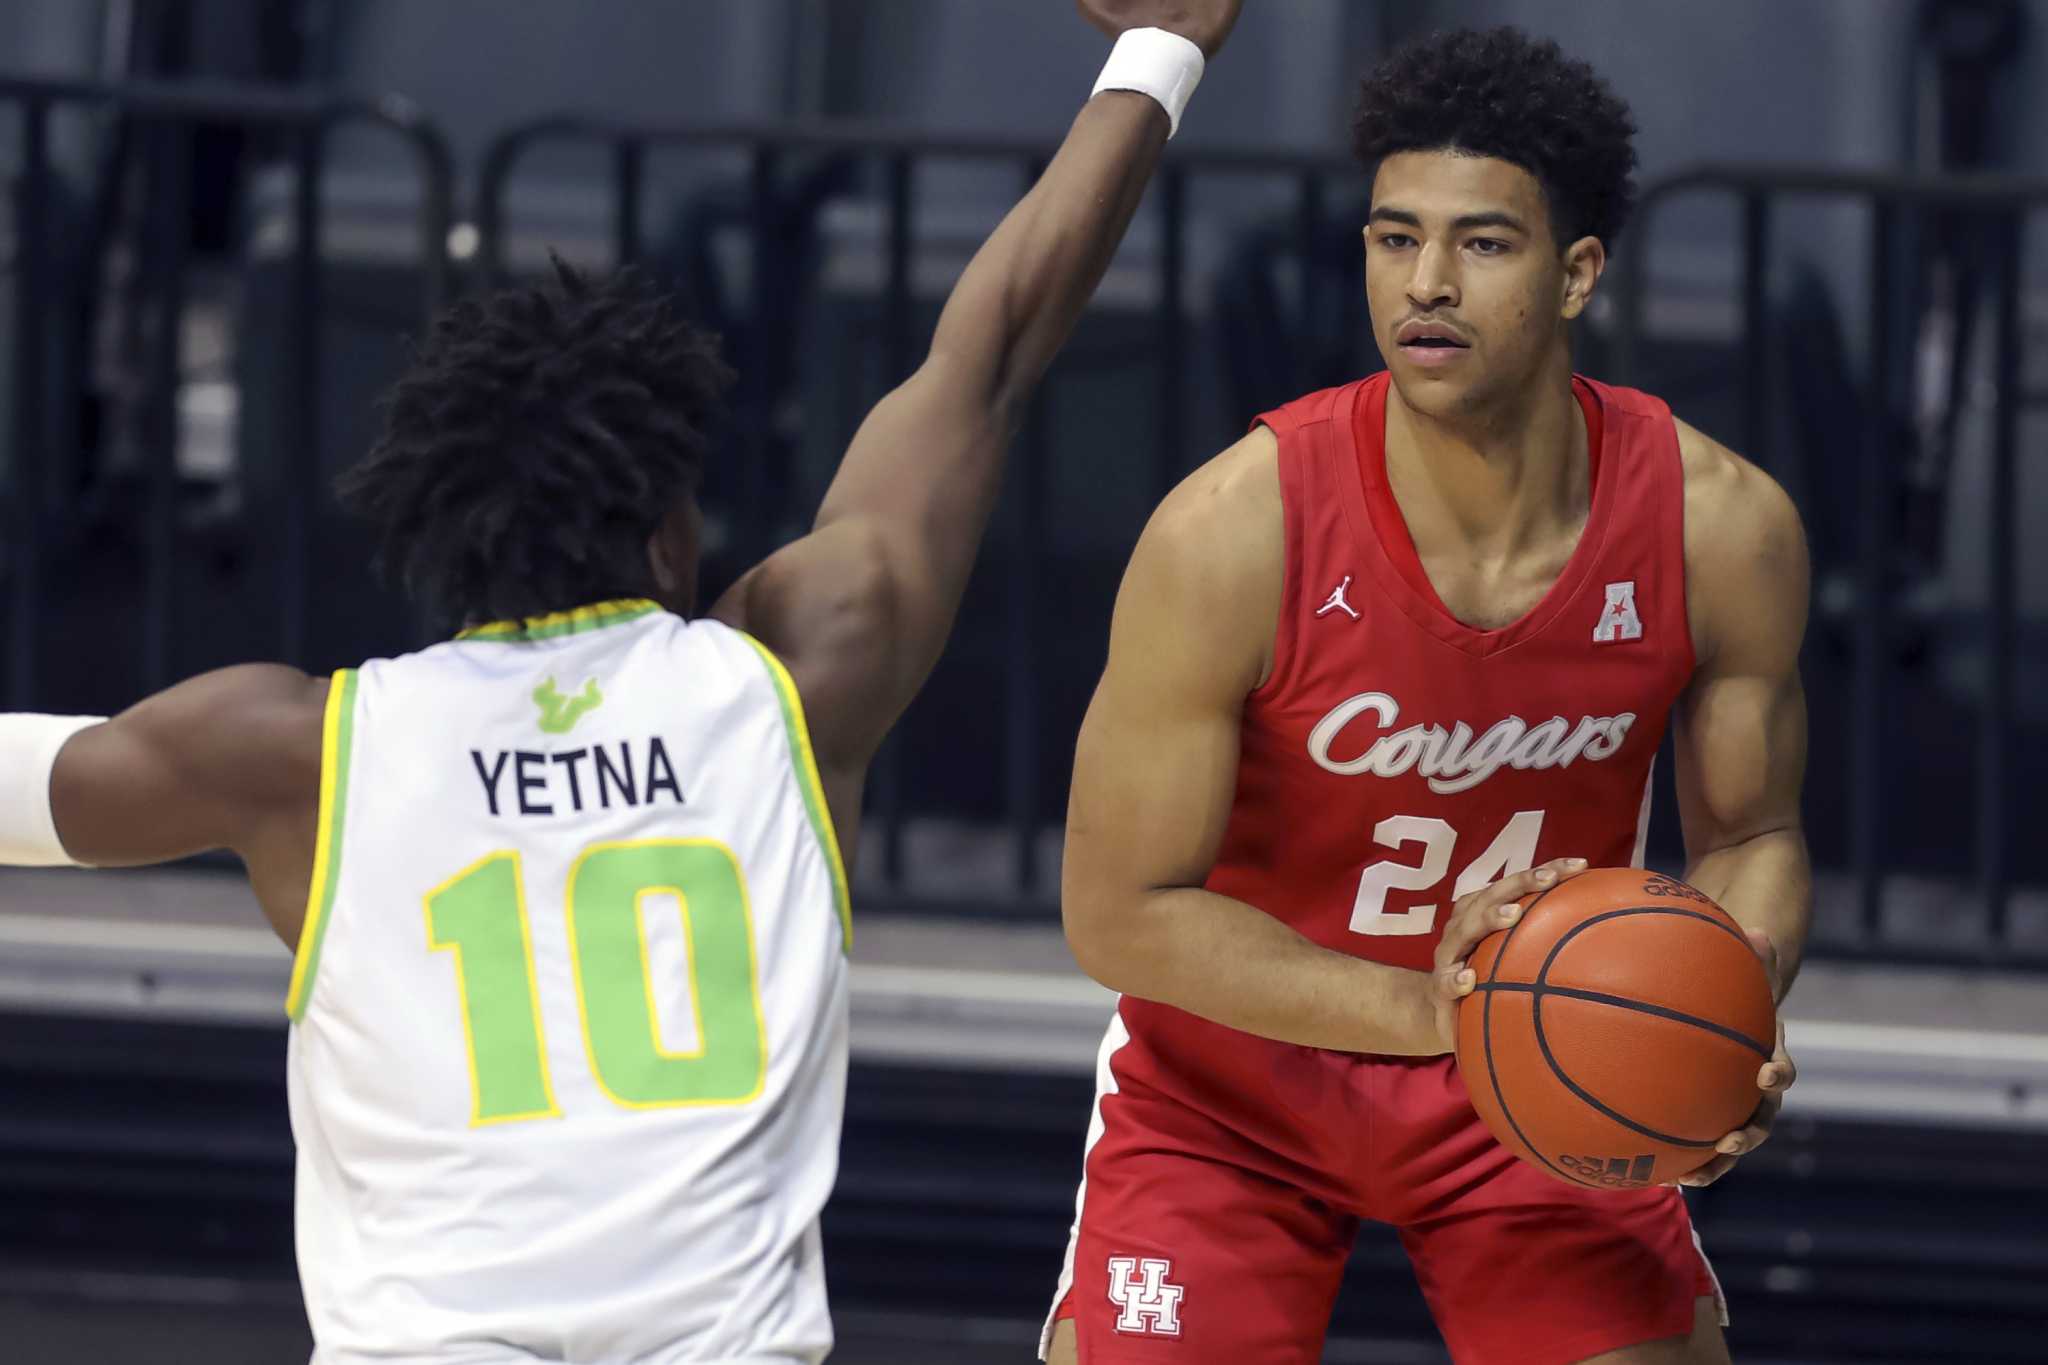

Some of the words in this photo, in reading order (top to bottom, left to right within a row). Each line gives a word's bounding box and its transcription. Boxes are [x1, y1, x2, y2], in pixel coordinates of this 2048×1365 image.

[470, 736, 686, 816] YETNA
[1307, 691, 1637, 795] Cougars
[1348, 809, 1545, 936] 24
[423, 836, 768, 1128] 10
